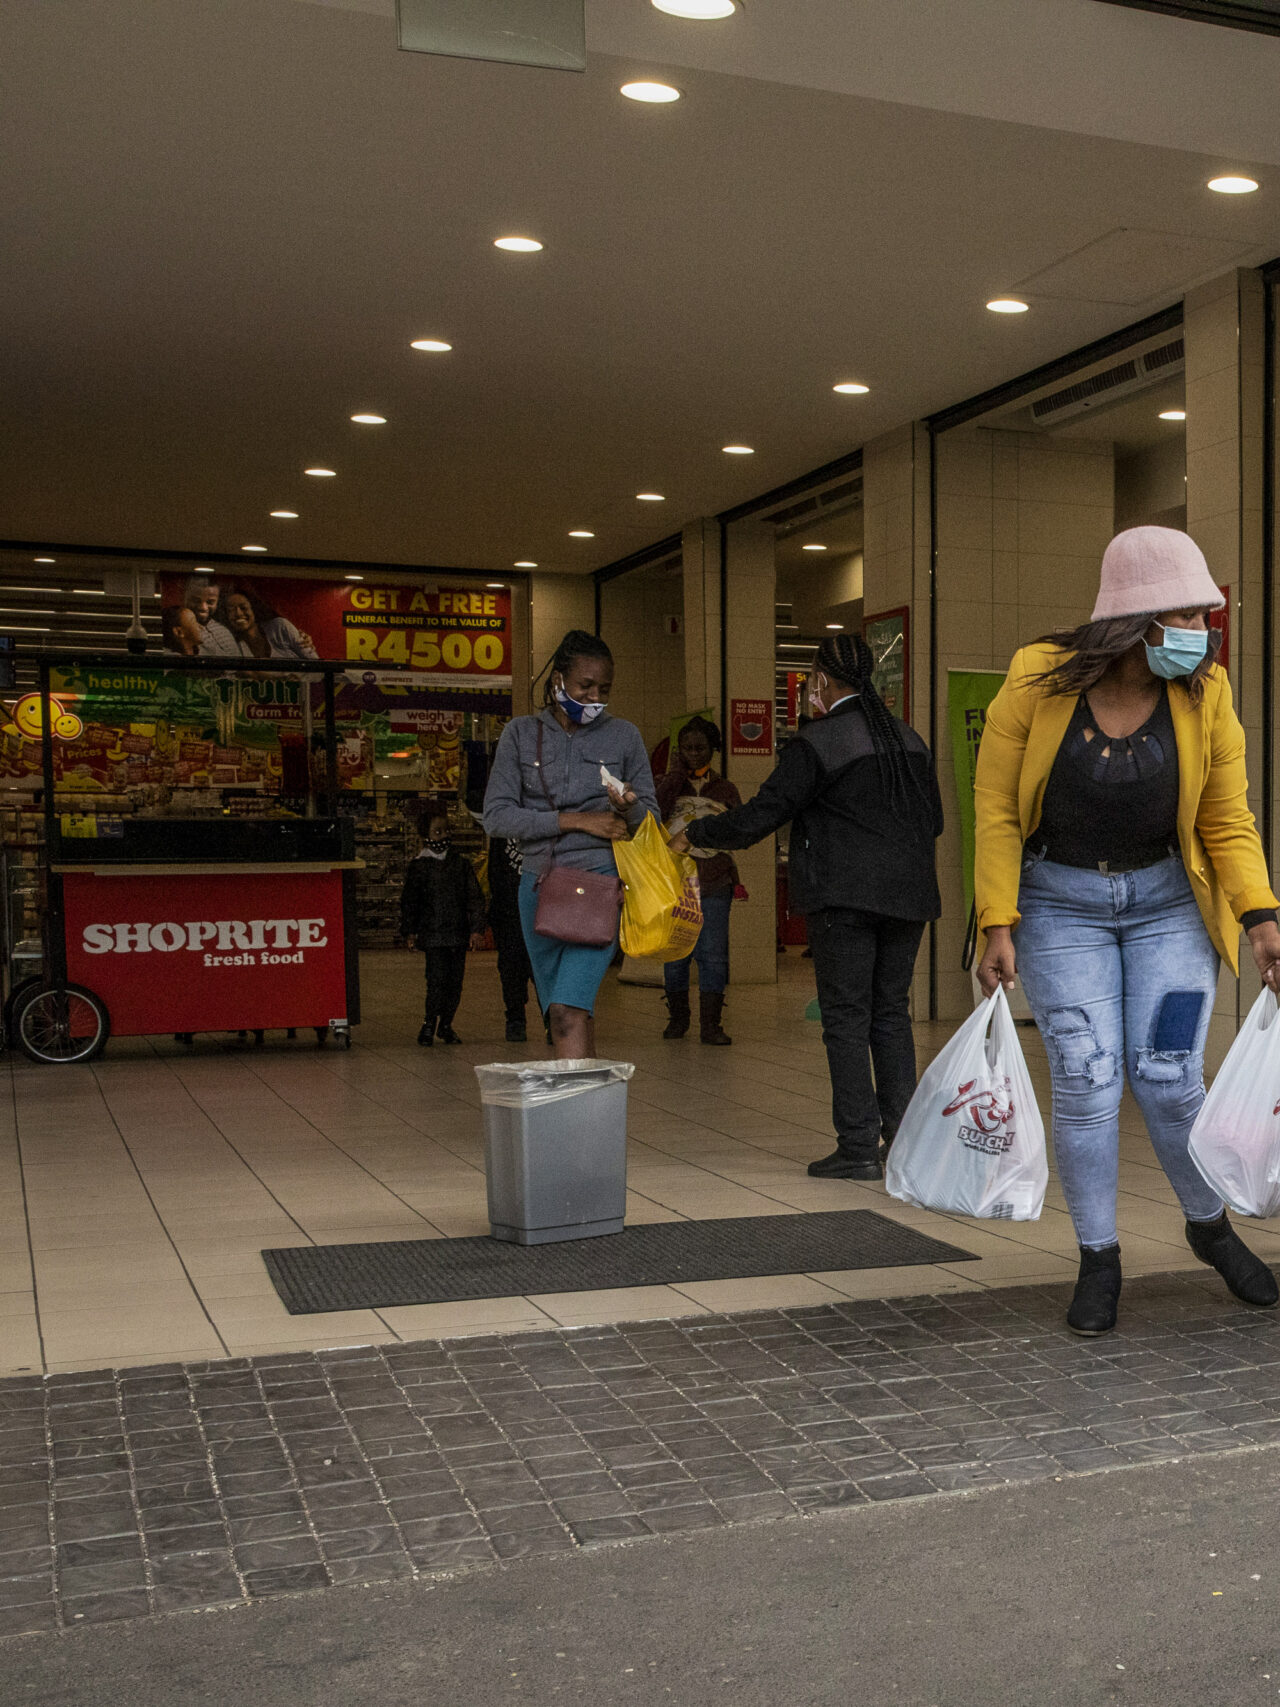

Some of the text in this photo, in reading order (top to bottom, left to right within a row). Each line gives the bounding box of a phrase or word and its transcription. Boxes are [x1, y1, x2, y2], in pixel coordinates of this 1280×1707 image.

[350, 588, 496, 615] GET A FREE
[346, 615, 503, 628] FUNERAL BENEFIT TO THE VALUE OF
[345, 628, 504, 671] R4500
[88, 675, 158, 693] healthy
[250, 706, 282, 718] farm
[407, 710, 445, 723] weigh
[417, 723, 439, 732] here
[83, 918, 328, 954] SHOPRITE
[203, 951, 304, 967] fresh food
